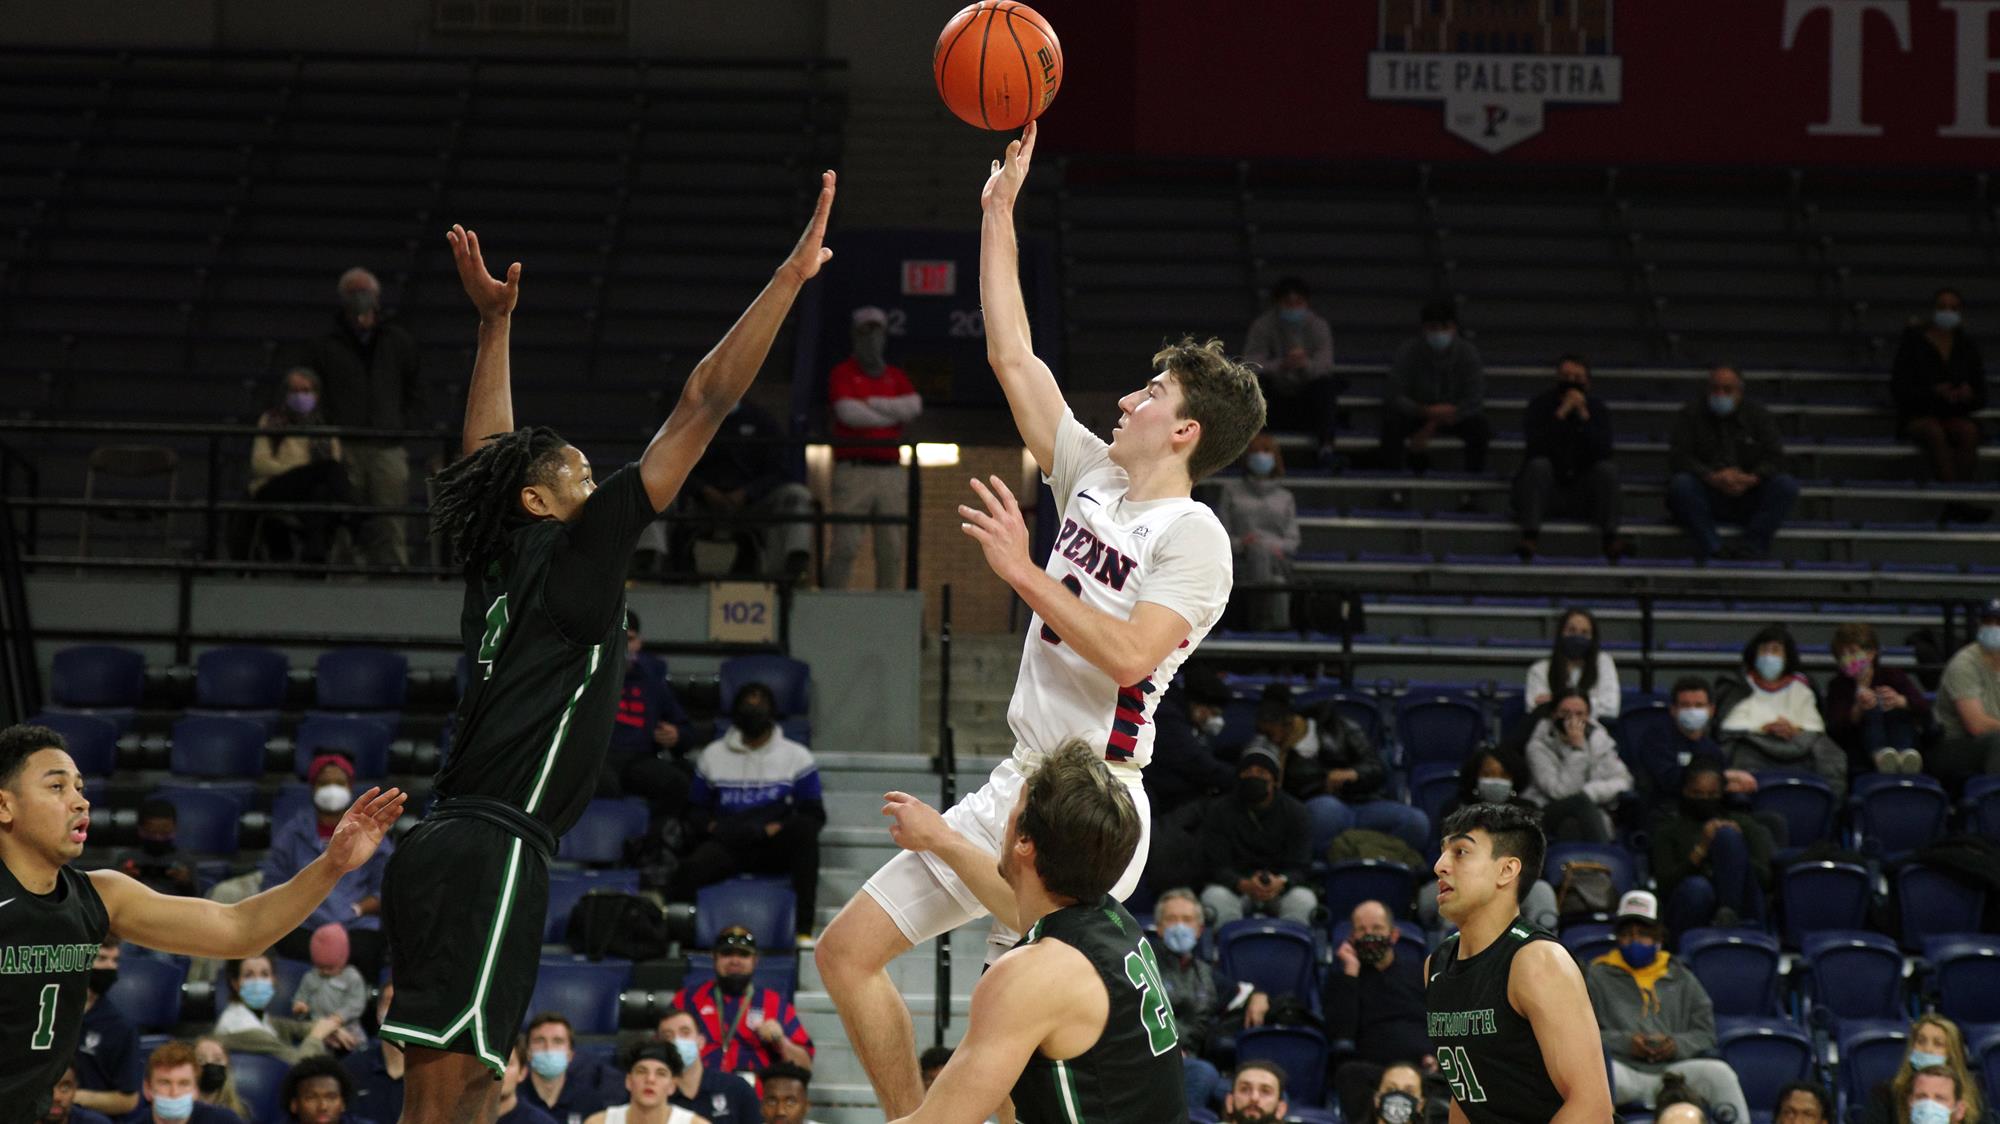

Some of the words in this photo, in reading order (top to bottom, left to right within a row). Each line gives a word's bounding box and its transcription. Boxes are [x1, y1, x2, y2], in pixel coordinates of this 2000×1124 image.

[1386, 60, 1441, 91] THE
[1454, 62, 1605, 94] PALESTRA
[888, 308, 907, 336] 2
[1053, 517, 1138, 592] PENN
[722, 603, 765, 625] 102
[477, 592, 509, 680] 4
[0, 944, 102, 974] ARTMOUT
[31, 983, 60, 1050] 1
[1426, 1008, 1498, 1037] RTMOUTH
[1436, 1046, 1488, 1103] 21
